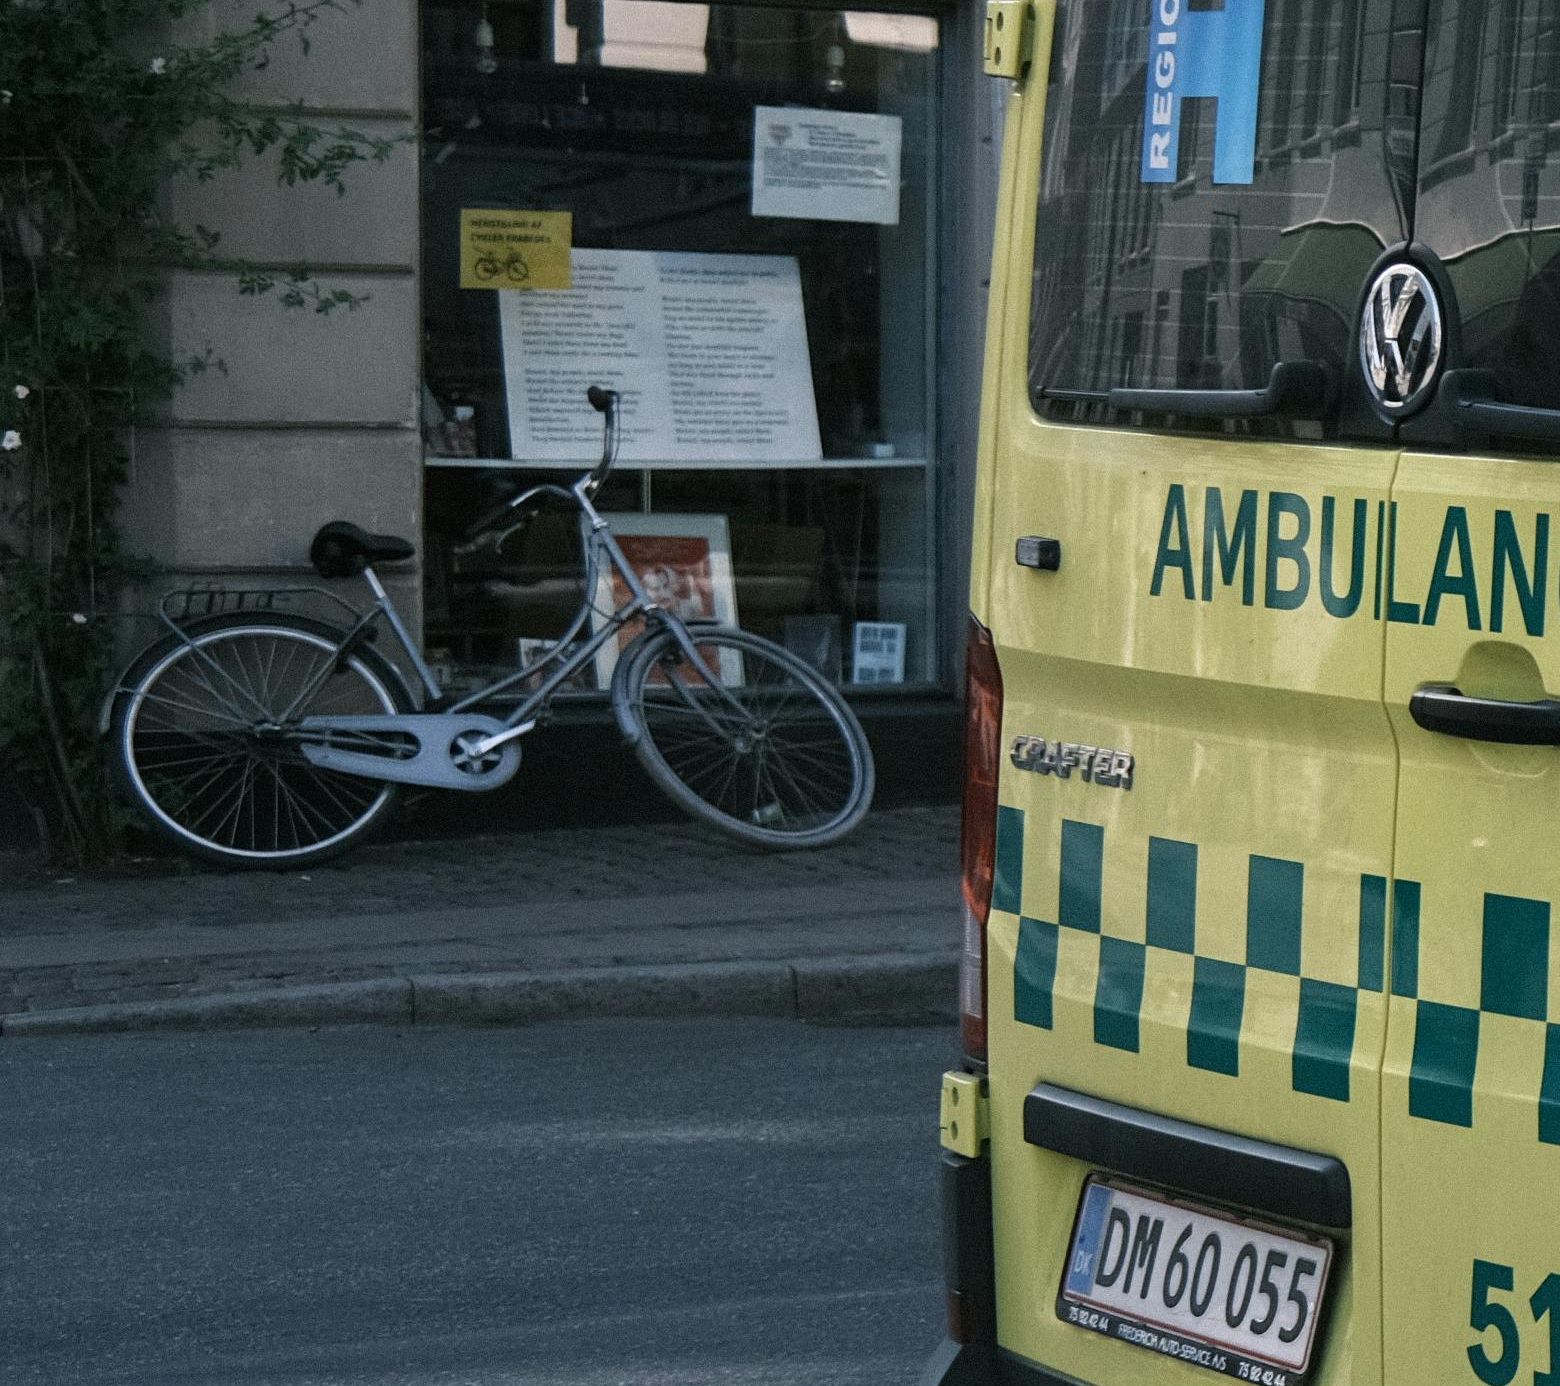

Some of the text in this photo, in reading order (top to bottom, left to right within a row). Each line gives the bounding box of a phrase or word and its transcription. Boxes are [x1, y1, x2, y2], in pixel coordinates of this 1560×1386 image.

[1010, 734, 1135, 790] CRAFTER
[1095, 1207, 1316, 1344] DM 60 055
